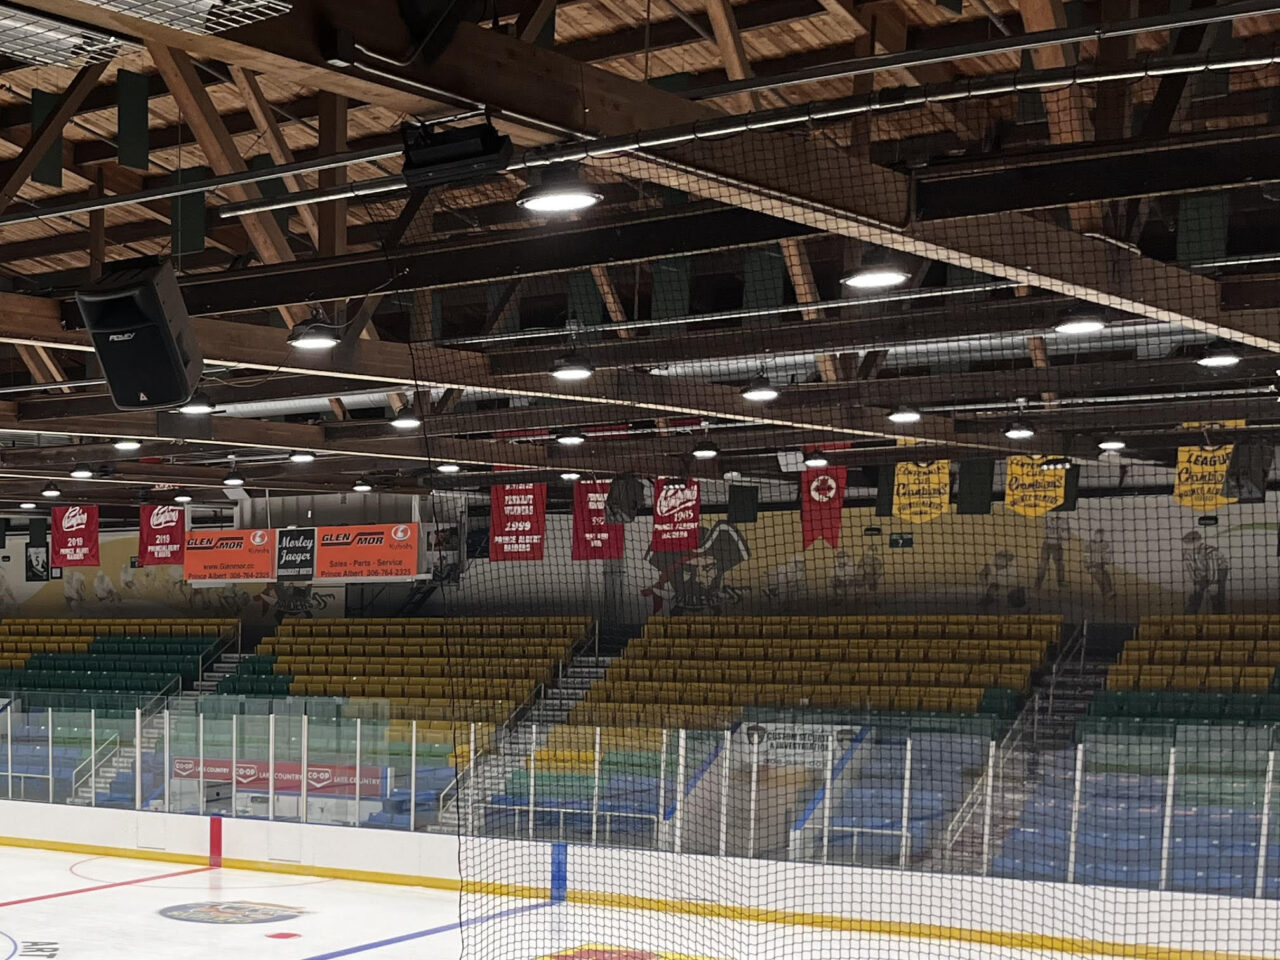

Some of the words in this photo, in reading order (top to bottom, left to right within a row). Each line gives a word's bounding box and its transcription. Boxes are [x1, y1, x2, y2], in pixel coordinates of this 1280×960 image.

[187, 538, 213, 546] GLEN
[216, 541, 244, 549] MOR
[279, 536, 313, 550] Morley
[322, 533, 351, 542] GLEN
[357, 536, 384, 545] MOR
[35, 556, 40, 567] 5
[329, 560, 348, 568] Sales
[800, 733, 829, 742] SECURIT
[236, 767, 255, 775] CO-OP
[308, 771, 329, 779] CO-OP
[21, 941, 59, 958] ART
